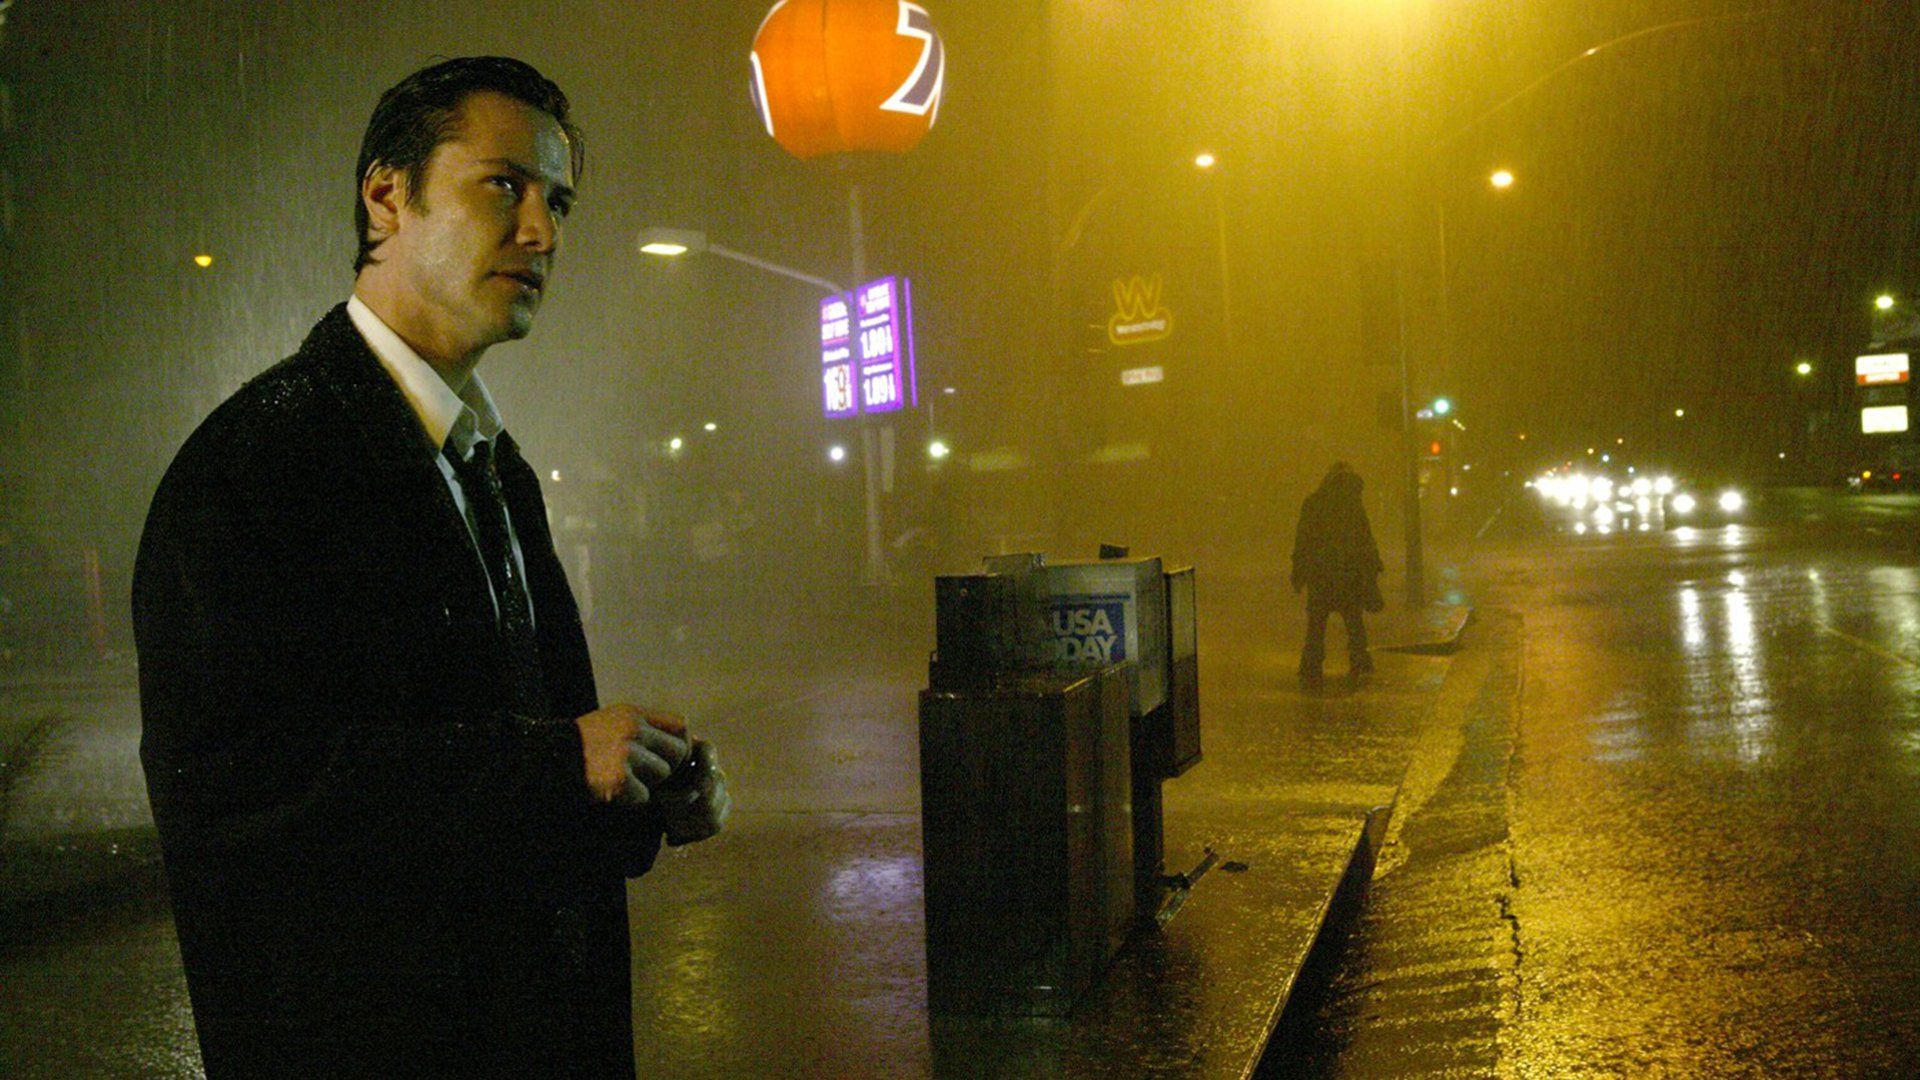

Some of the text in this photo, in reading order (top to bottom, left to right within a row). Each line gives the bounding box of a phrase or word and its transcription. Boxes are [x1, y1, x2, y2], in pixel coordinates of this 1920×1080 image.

[1112, 274, 1163, 320] W
[1053, 609, 1113, 636] USA
[1046, 636, 1117, 664] DAY
